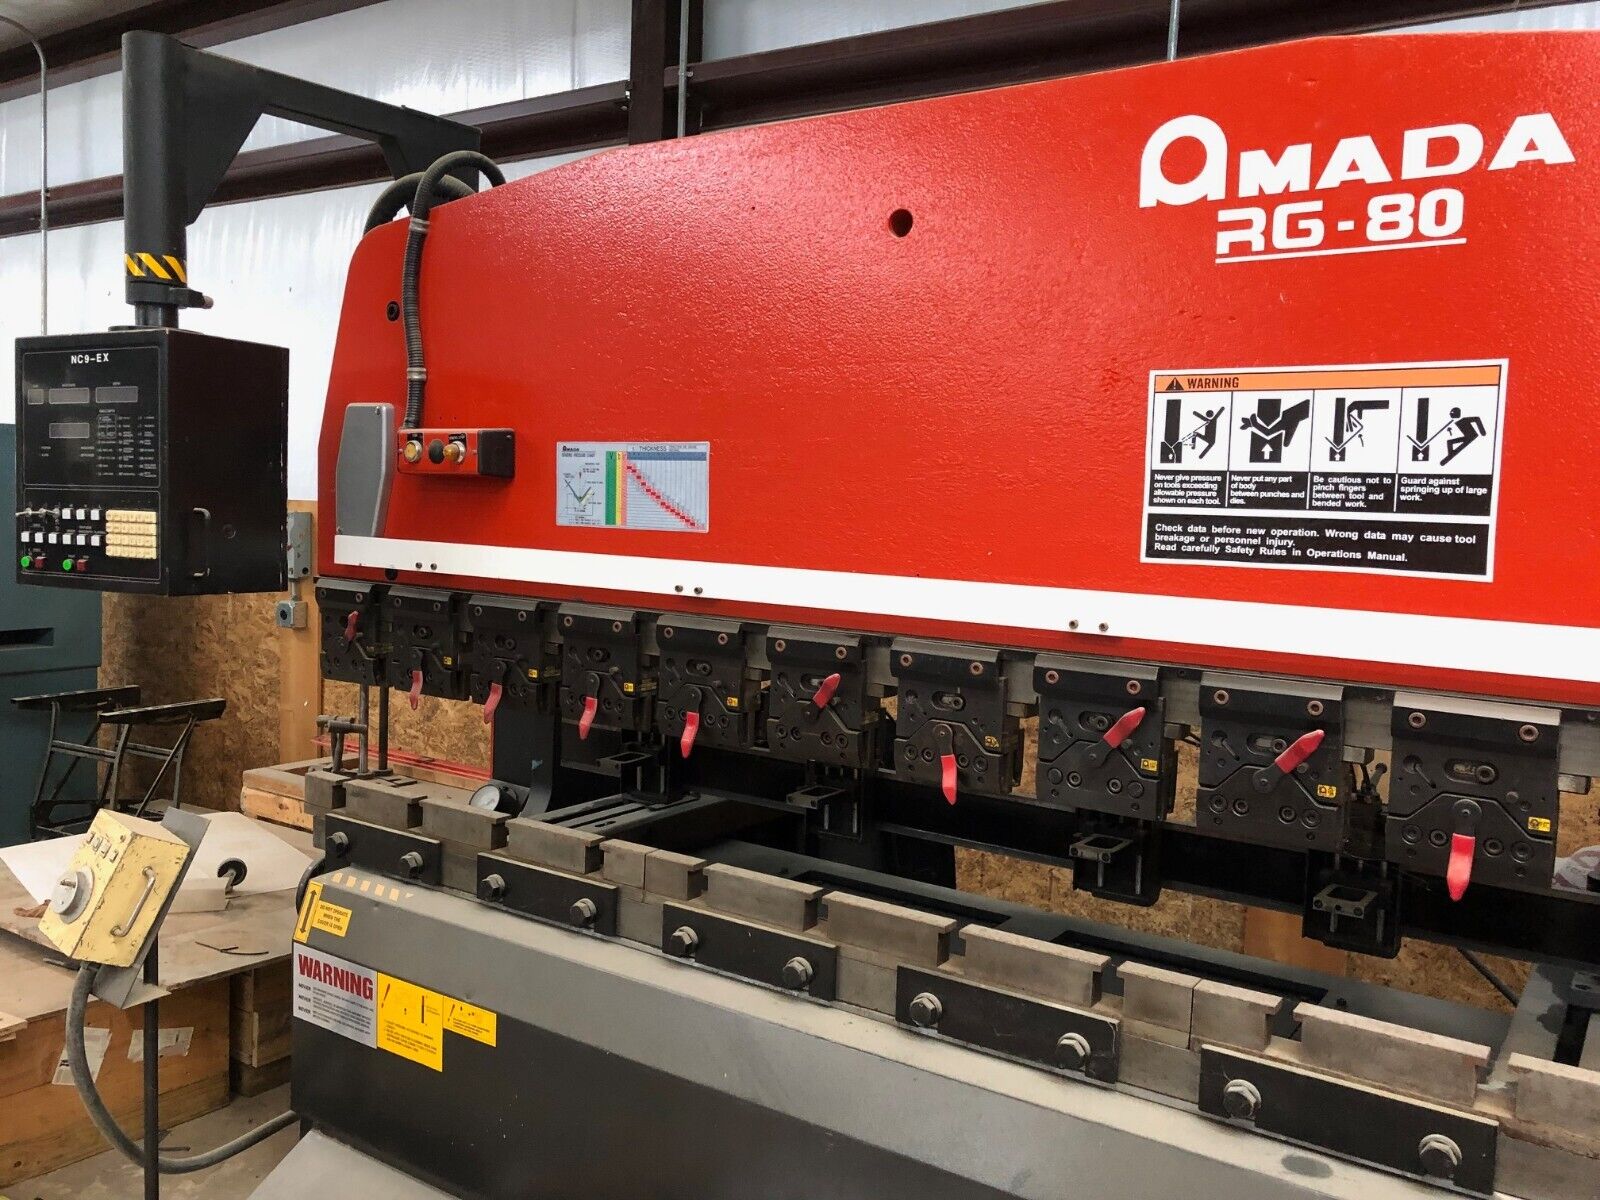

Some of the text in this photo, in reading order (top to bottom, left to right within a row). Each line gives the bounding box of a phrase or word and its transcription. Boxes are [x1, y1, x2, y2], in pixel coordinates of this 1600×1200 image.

[1139, 112, 1576, 208] AMADA
[71, 352, 109, 364] NC9-EX
[1187, 377, 1240, 389] WARNING
[1175, 474, 1190, 482] give
[1231, 474, 1251, 482] Never
[1252, 475, 1264, 483] put
[1278, 475, 1293, 483] part
[1313, 475, 1324, 483] Be
[1328, 476, 1362, 484] cautious
[1400, 477, 1460, 486] Guard against
[1182, 482, 1218, 490] exceeding
[1239, 482, 1256, 490] body
[1312, 484, 1366, 493] pinch fingers
[1400, 486, 1488, 495] springing up of large
[1260, 490, 1290, 498] punches
[1349, 492, 1365, 500] tool
[1311, 499, 1367, 508] bended work.
[1155, 523, 1476, 544] Check data before new operation. Wrong data may cause tool
[1154, 533, 1296, 547] breakage or personnel injury.
[1154, 542, 1408, 562] Read carefully Safety Rules in Operations Manual.
[298, 953, 374, 1001] WARNING
